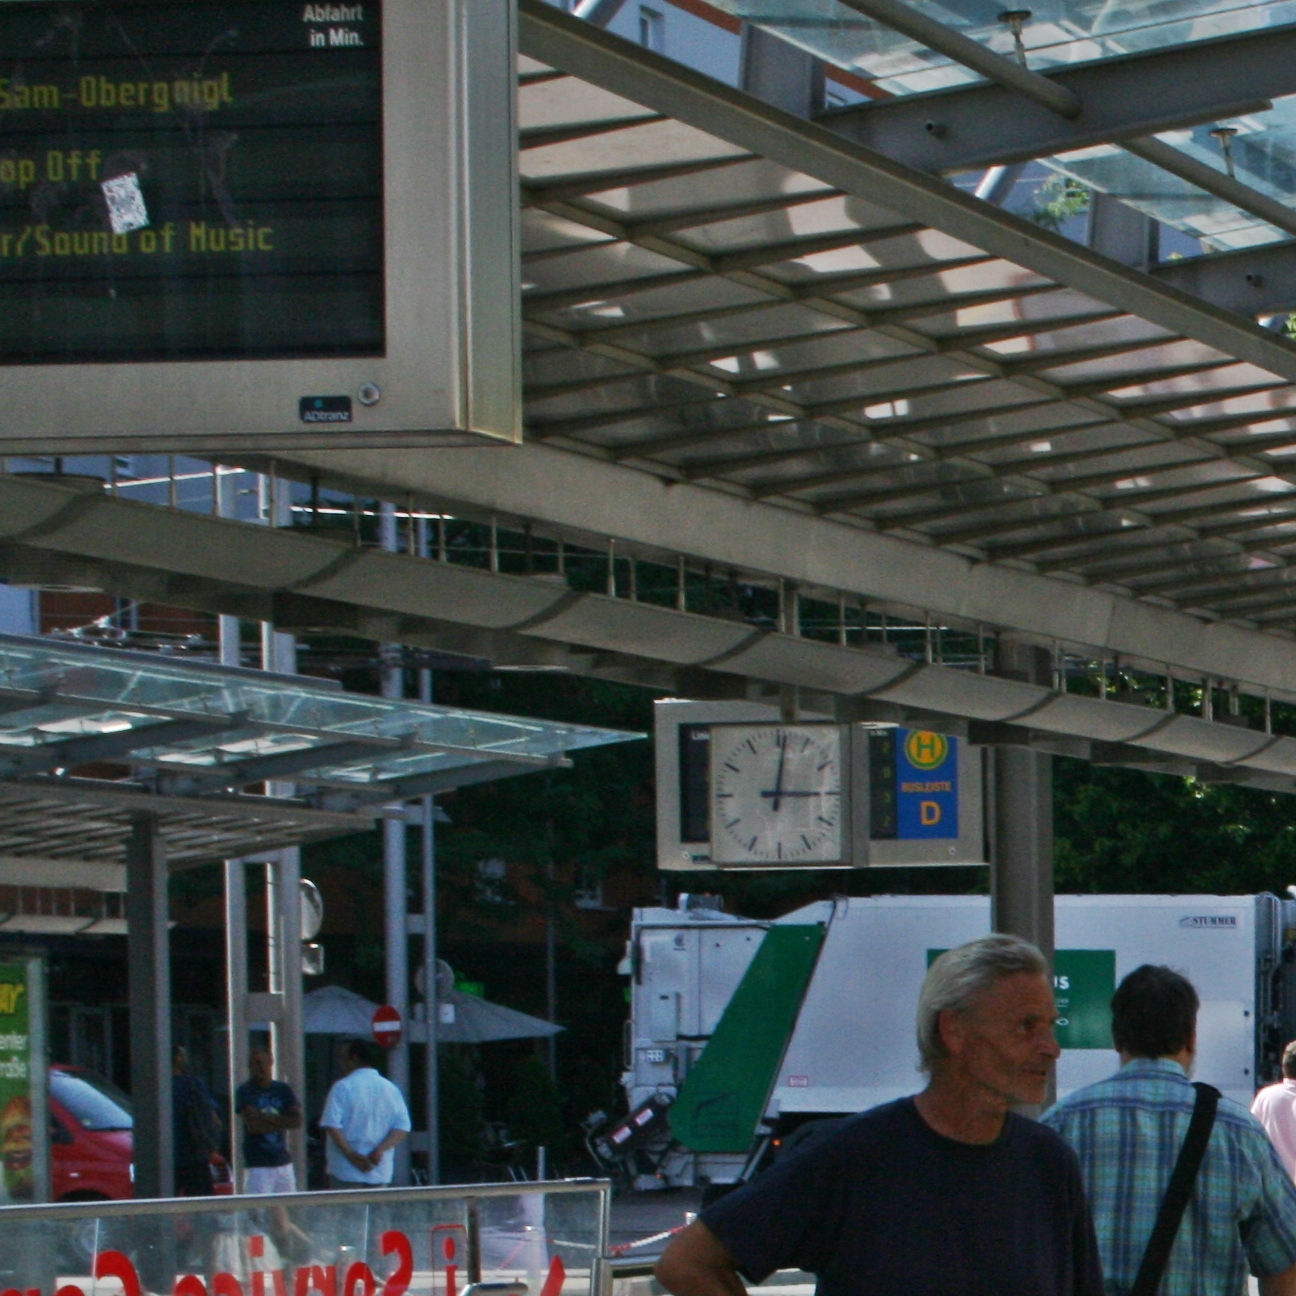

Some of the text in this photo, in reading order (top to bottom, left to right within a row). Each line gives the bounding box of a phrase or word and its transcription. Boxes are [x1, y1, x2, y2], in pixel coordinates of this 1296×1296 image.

[303, 3, 363, 21] Abfahrt
[310, 27, 364, 47] in Min.
[47, 151, 101, 182] Off
[139, 221, 176, 254] of
[189, 219, 274, 251] Music
[916, 735, 936, 759] H
[921, 801, 941, 826] D
